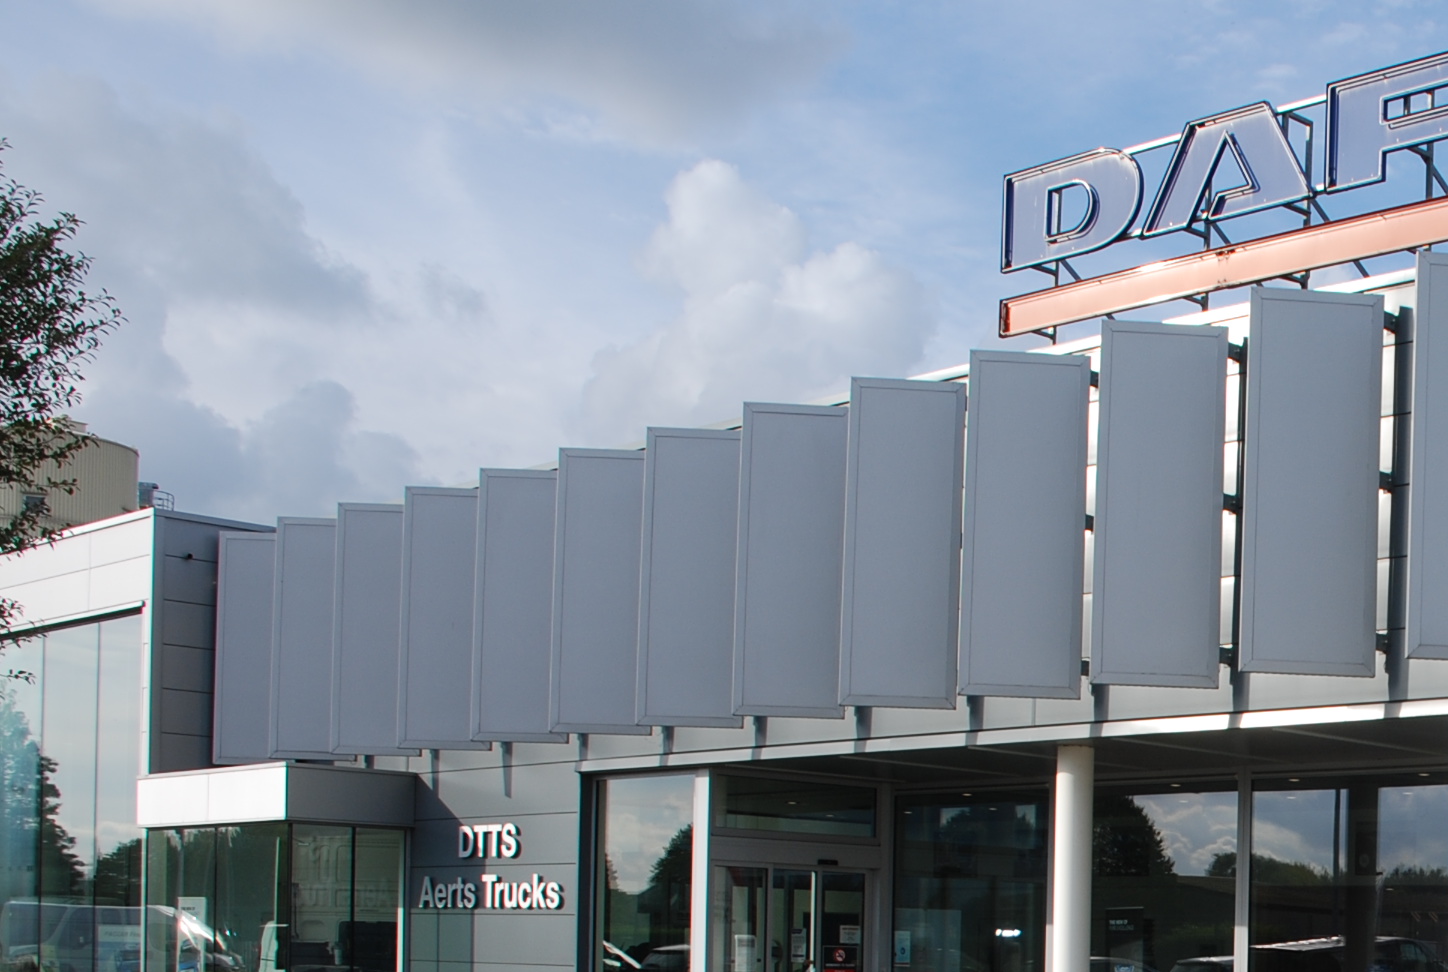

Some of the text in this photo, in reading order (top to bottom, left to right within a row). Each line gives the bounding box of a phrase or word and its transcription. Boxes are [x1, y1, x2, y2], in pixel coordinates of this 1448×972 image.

[458, 822, 520, 858] DTTS
[418, 876, 477, 909] Aerts
[481, 873, 562, 909] Trucks
